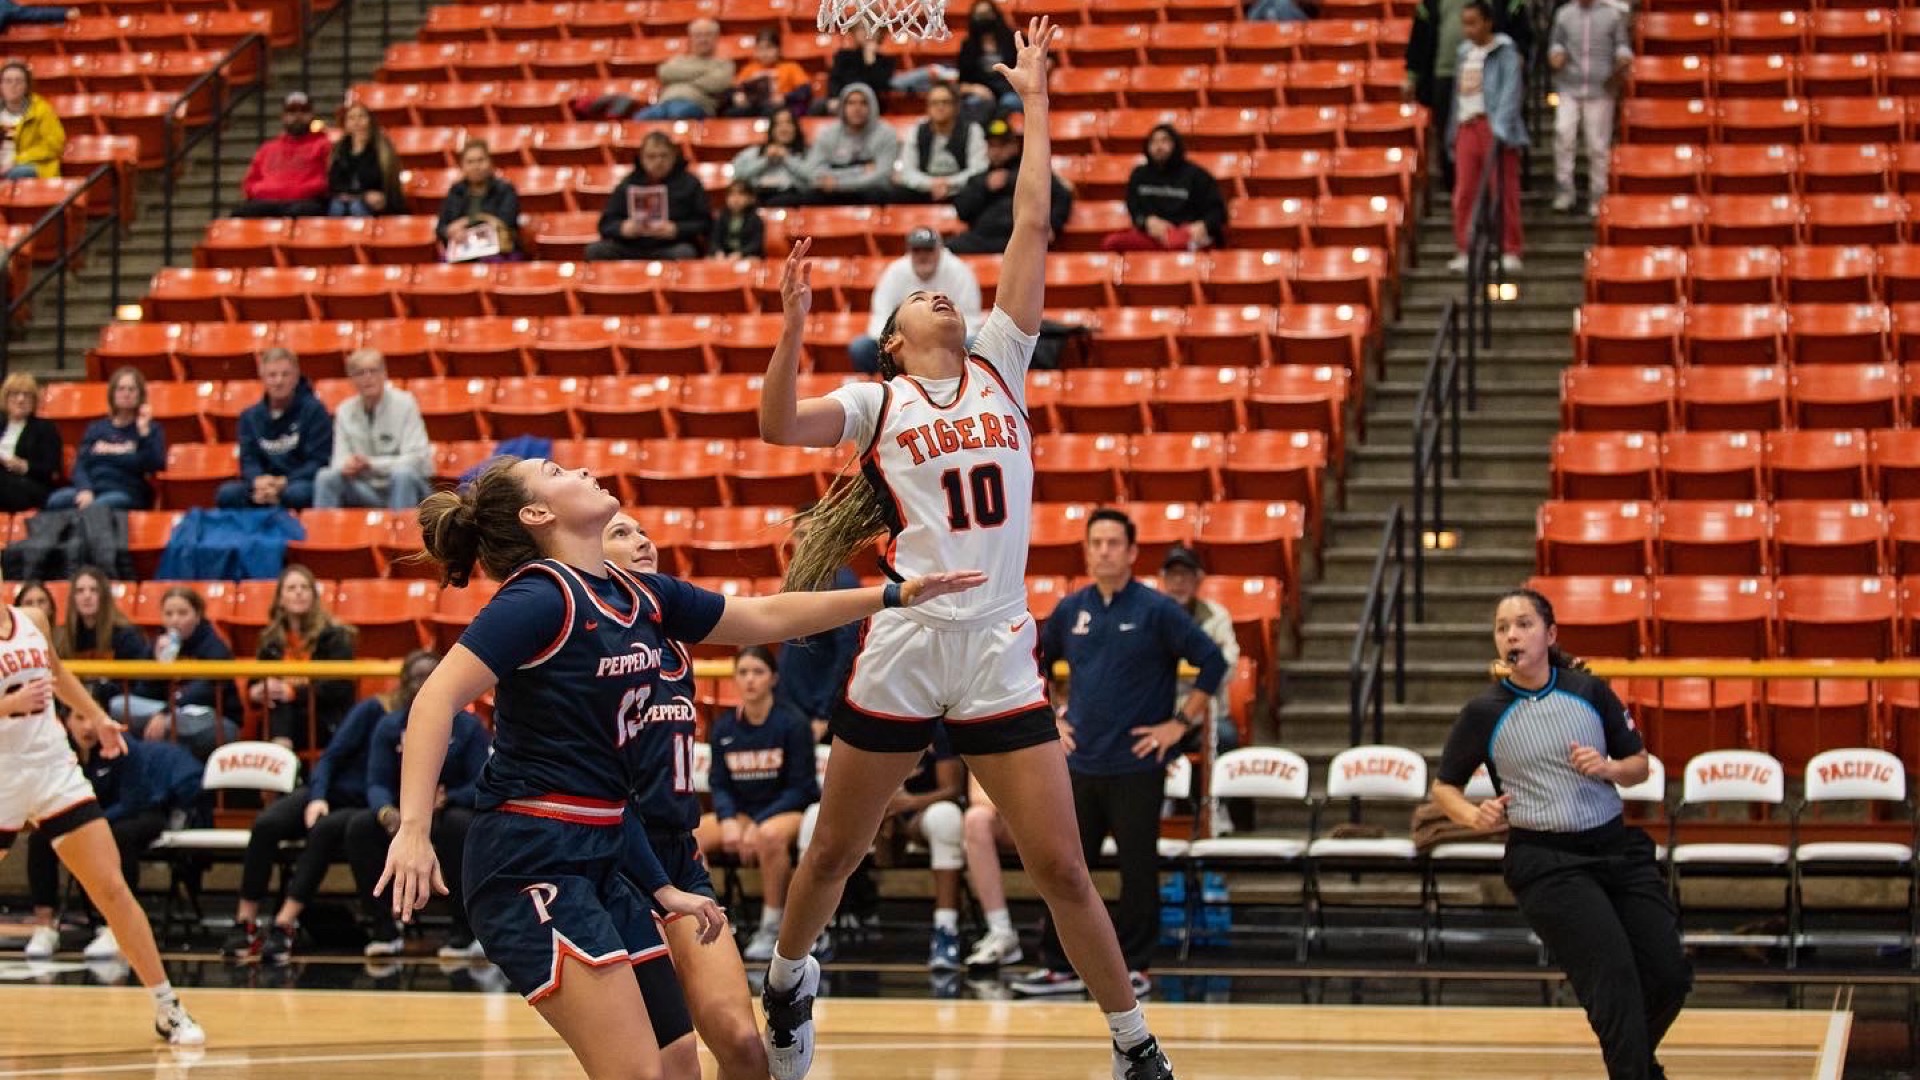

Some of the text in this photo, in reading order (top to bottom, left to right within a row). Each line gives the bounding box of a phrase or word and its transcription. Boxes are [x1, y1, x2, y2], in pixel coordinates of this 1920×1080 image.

[896, 412, 1020, 466] TIGERS
[940, 461, 1008, 533] 10
[217, 754, 285, 775] PACIFIC
[1225, 758, 1298, 781] PACIFIC
[1342, 758, 1415, 781] PACIFIC
[1696, 762, 1772, 785] PACIFIC
[1817, 760, 1893, 784] PACIFIC
[519, 883, 558, 925] P
